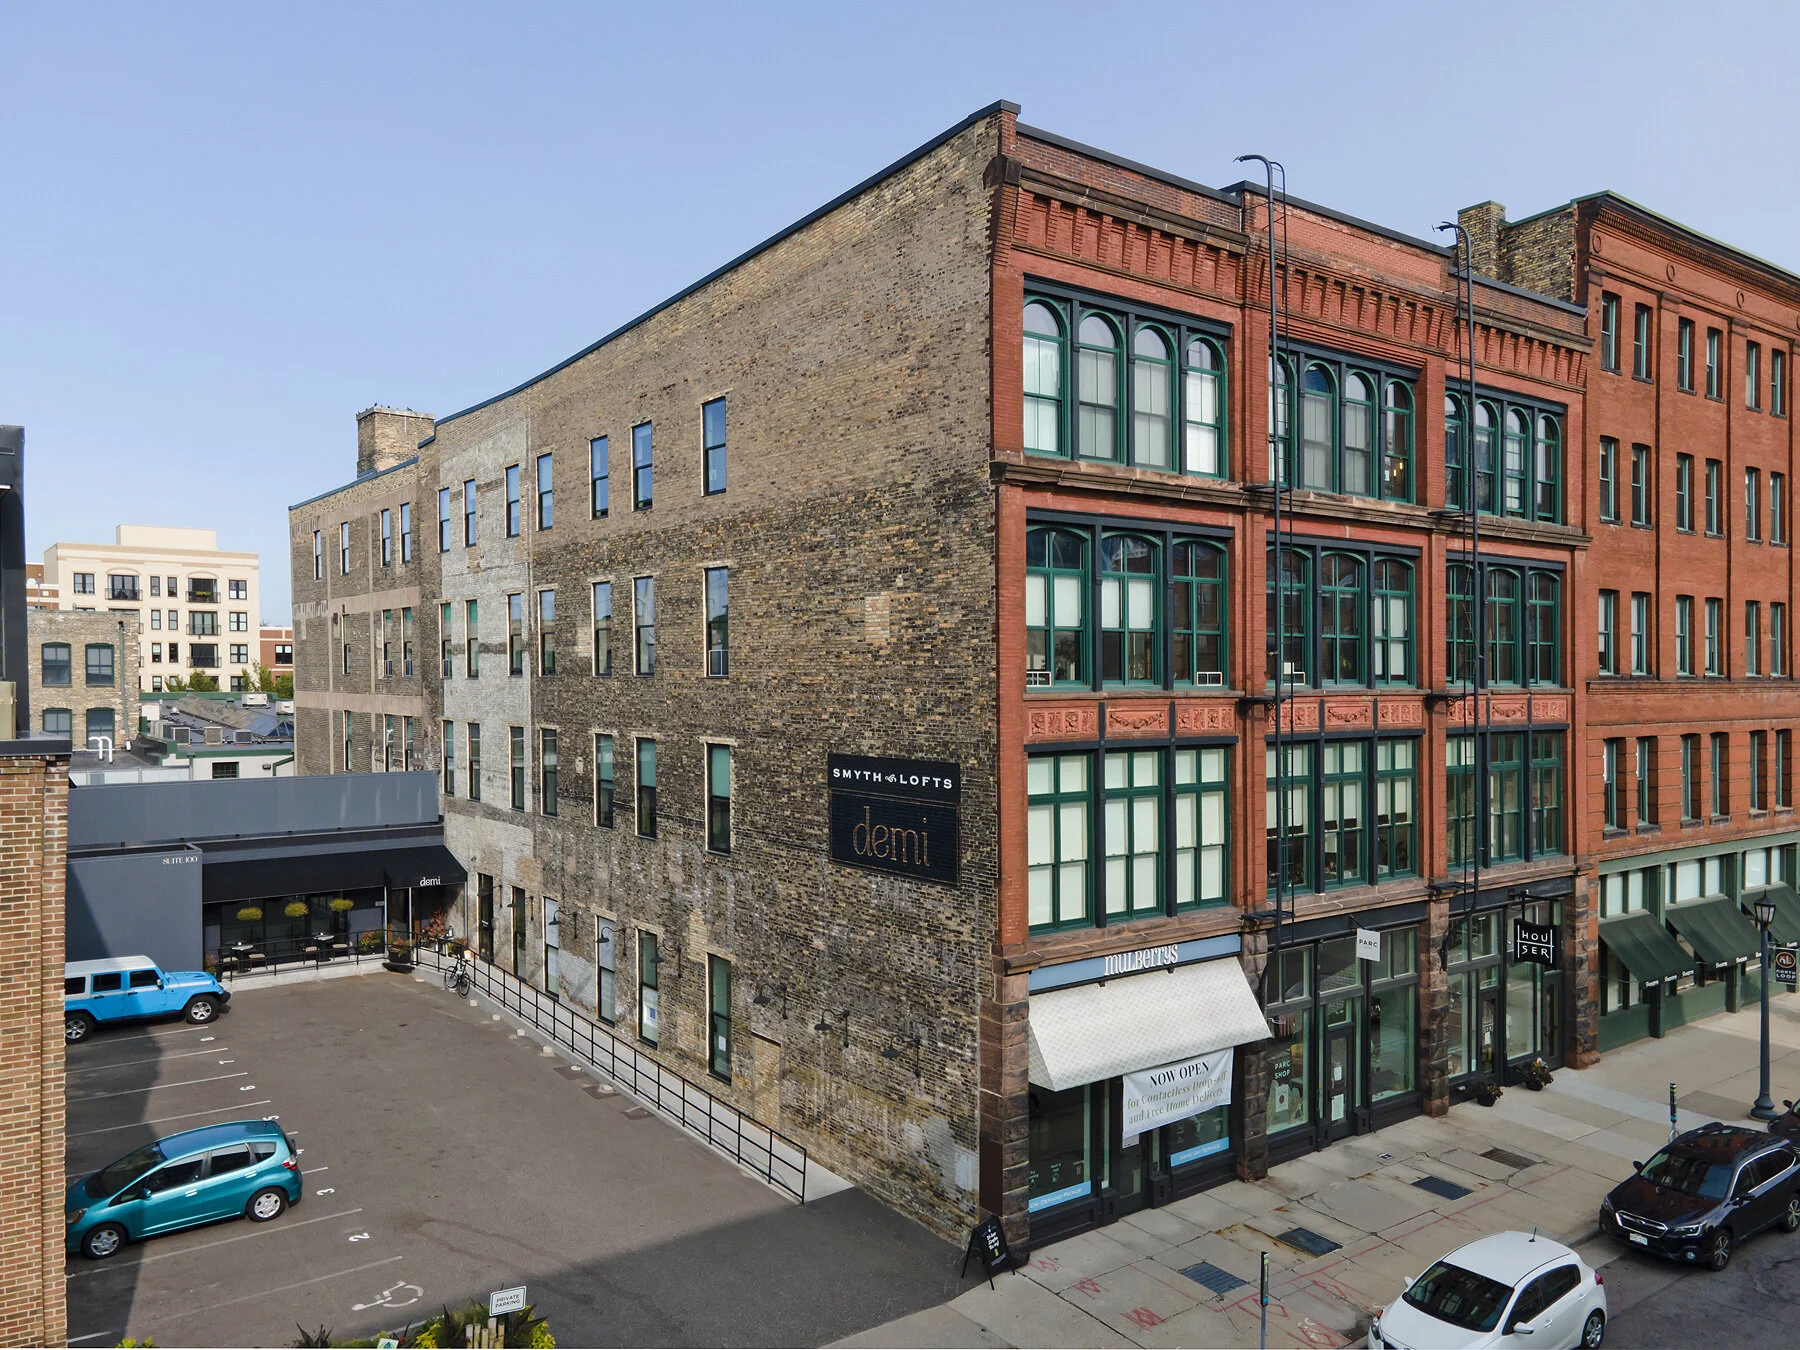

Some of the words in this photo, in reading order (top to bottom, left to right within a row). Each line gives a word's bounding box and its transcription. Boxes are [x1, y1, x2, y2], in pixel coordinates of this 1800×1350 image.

[832, 768, 882, 783] SMYTH
[899, 774, 953, 789] LOFTS
[852, 805, 931, 867] demi
[162, 856, 184, 865] SUITE
[419, 876, 441, 887] demi
[1521, 930, 1548, 942] HOU
[1358, 938, 1378, 948] PARC
[1521, 945, 1550, 959] SER
[1274, 1060, 1291, 1070] PARC
[1150, 1069, 1176, 1088] NOW
[1179, 1060, 1210, 1080] OPEN
[1274, 1070, 1291, 1080] SHOP
[1127, 1098, 1140, 1110] for
[1142, 1084, 1191, 1104] Contactless
[1128, 1110, 1144, 1125] and
[1146, 1104, 1164, 1119] Free
[1166, 1098, 1190, 1113] Home
[1192, 1088, 1224, 1105] Delivery
[316, 1188, 335, 1196] 3
[348, 1232, 370, 1242] 2
[495, 1298, 521, 1308] PARKING
[496, 1293, 520, 1303] PRIVATE
